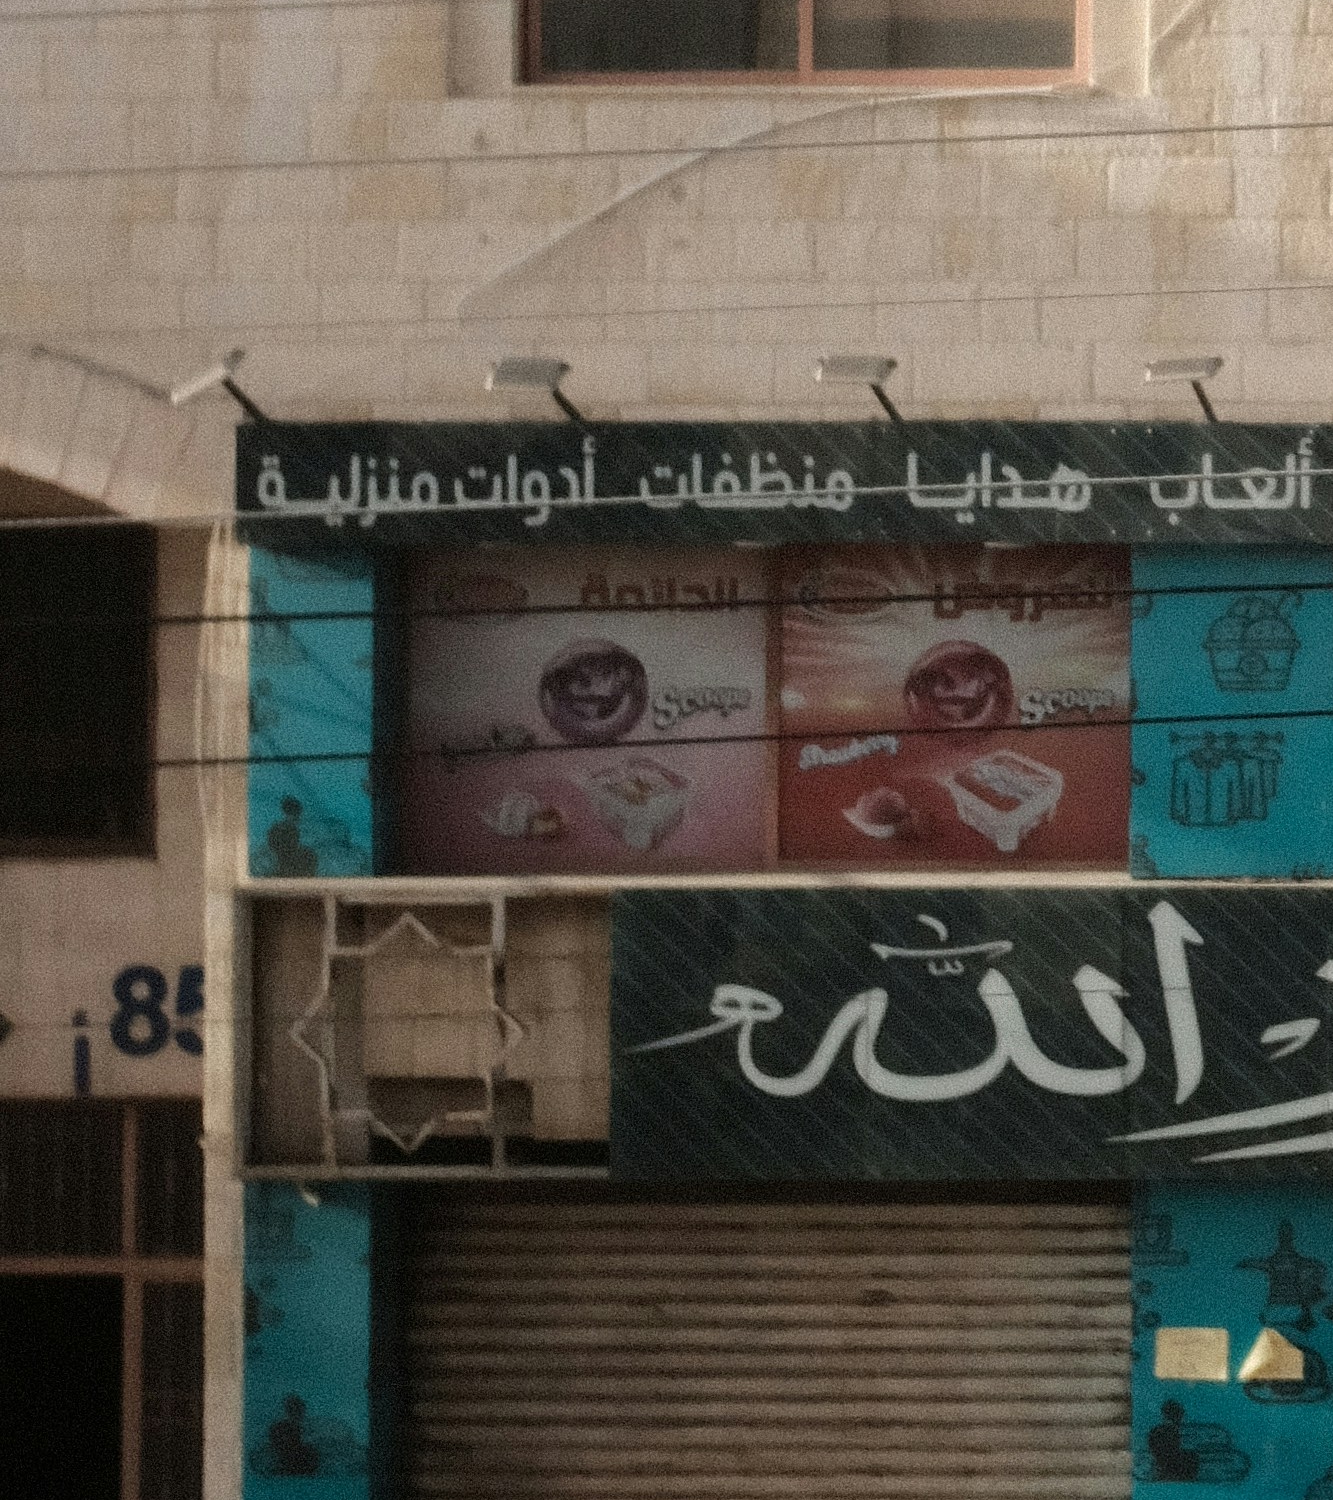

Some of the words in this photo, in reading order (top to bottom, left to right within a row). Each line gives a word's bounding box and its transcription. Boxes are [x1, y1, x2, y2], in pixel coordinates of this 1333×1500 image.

[256, 452, 438, 526] منزلية
[454, 434, 597, 526] أدوات
[638, 452, 856, 510] منظفات
[906, 452, 1092, 524] هدايا
[1148, 437, 1314, 526] ألعاب
[625, 902, 1204, 1104] الله
